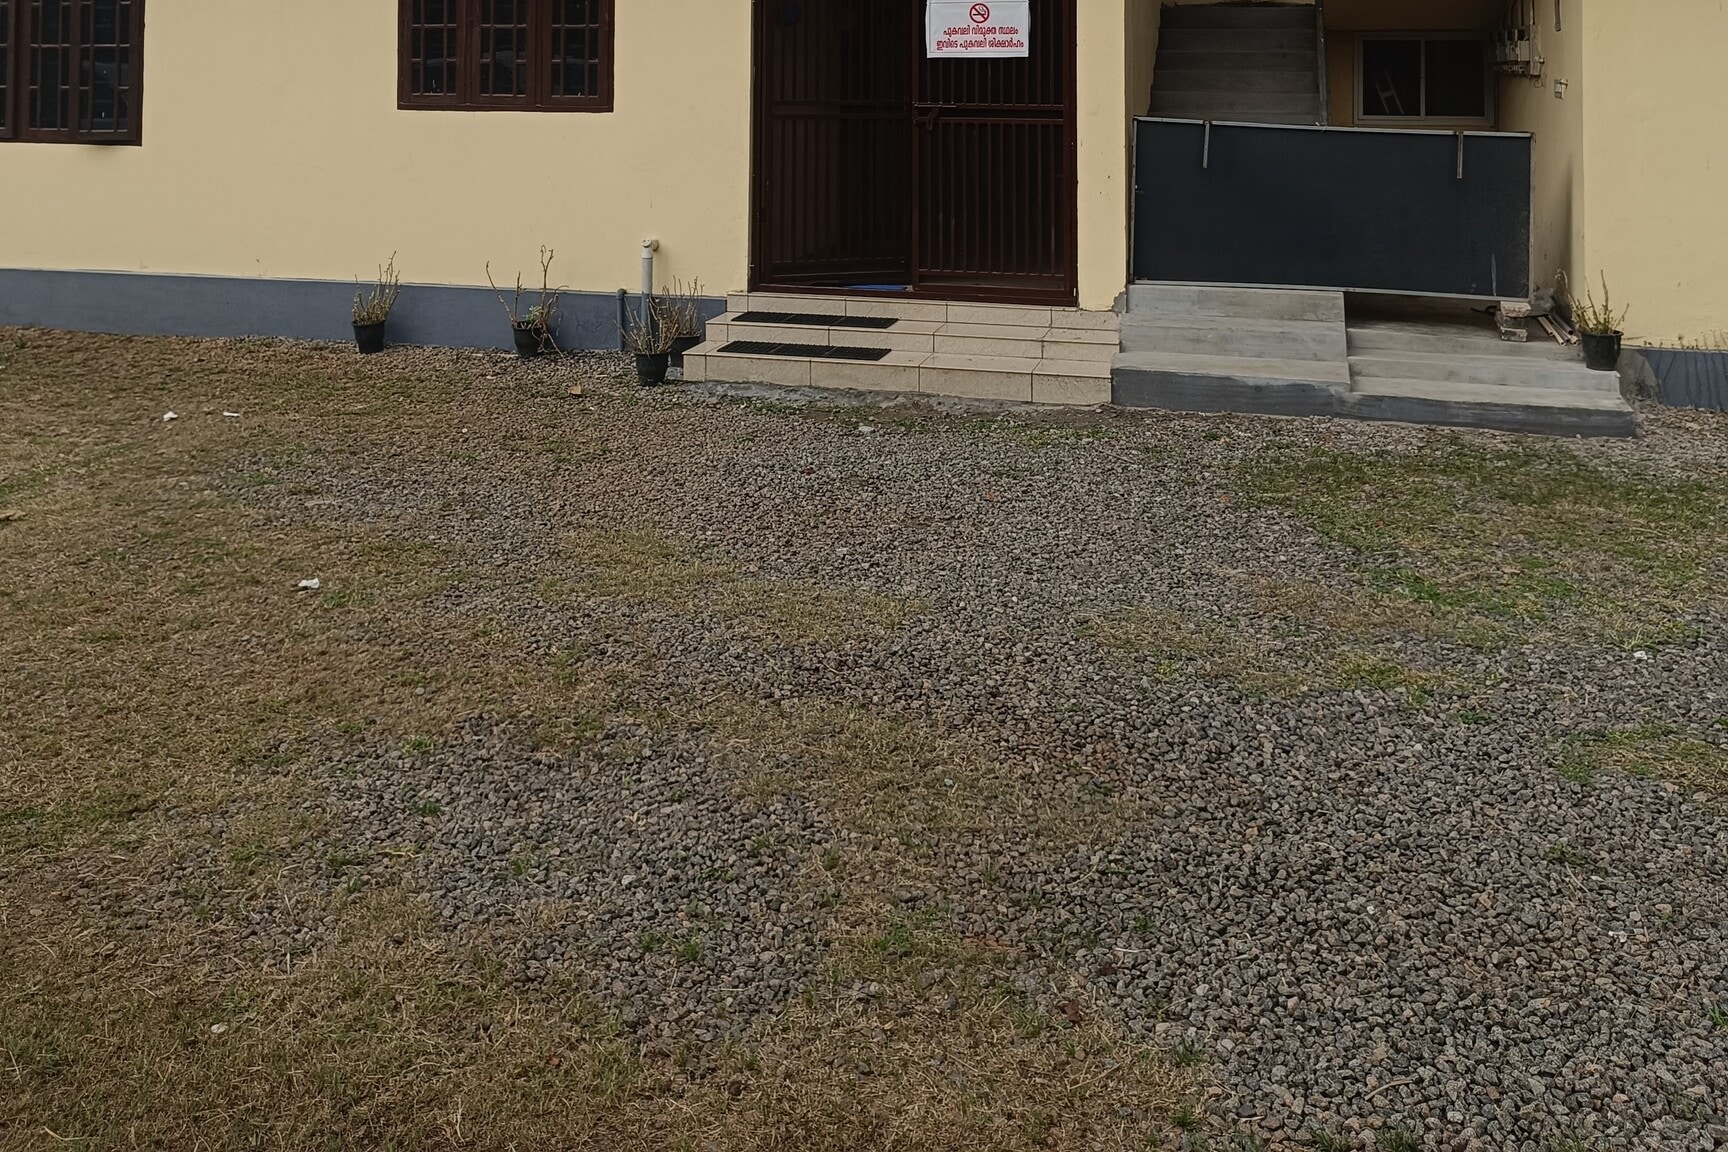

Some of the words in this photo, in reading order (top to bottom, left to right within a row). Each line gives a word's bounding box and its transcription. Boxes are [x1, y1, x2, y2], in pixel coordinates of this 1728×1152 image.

[942, 24, 971, 37] പുകവലി
[972, 24, 997, 37] വിമുക്ത
[998, 26, 1019, 35] സ്ഥലം
[936, 38, 958, 51] ഇവിടെ
[959, 37, 987, 50] പുകവലി
